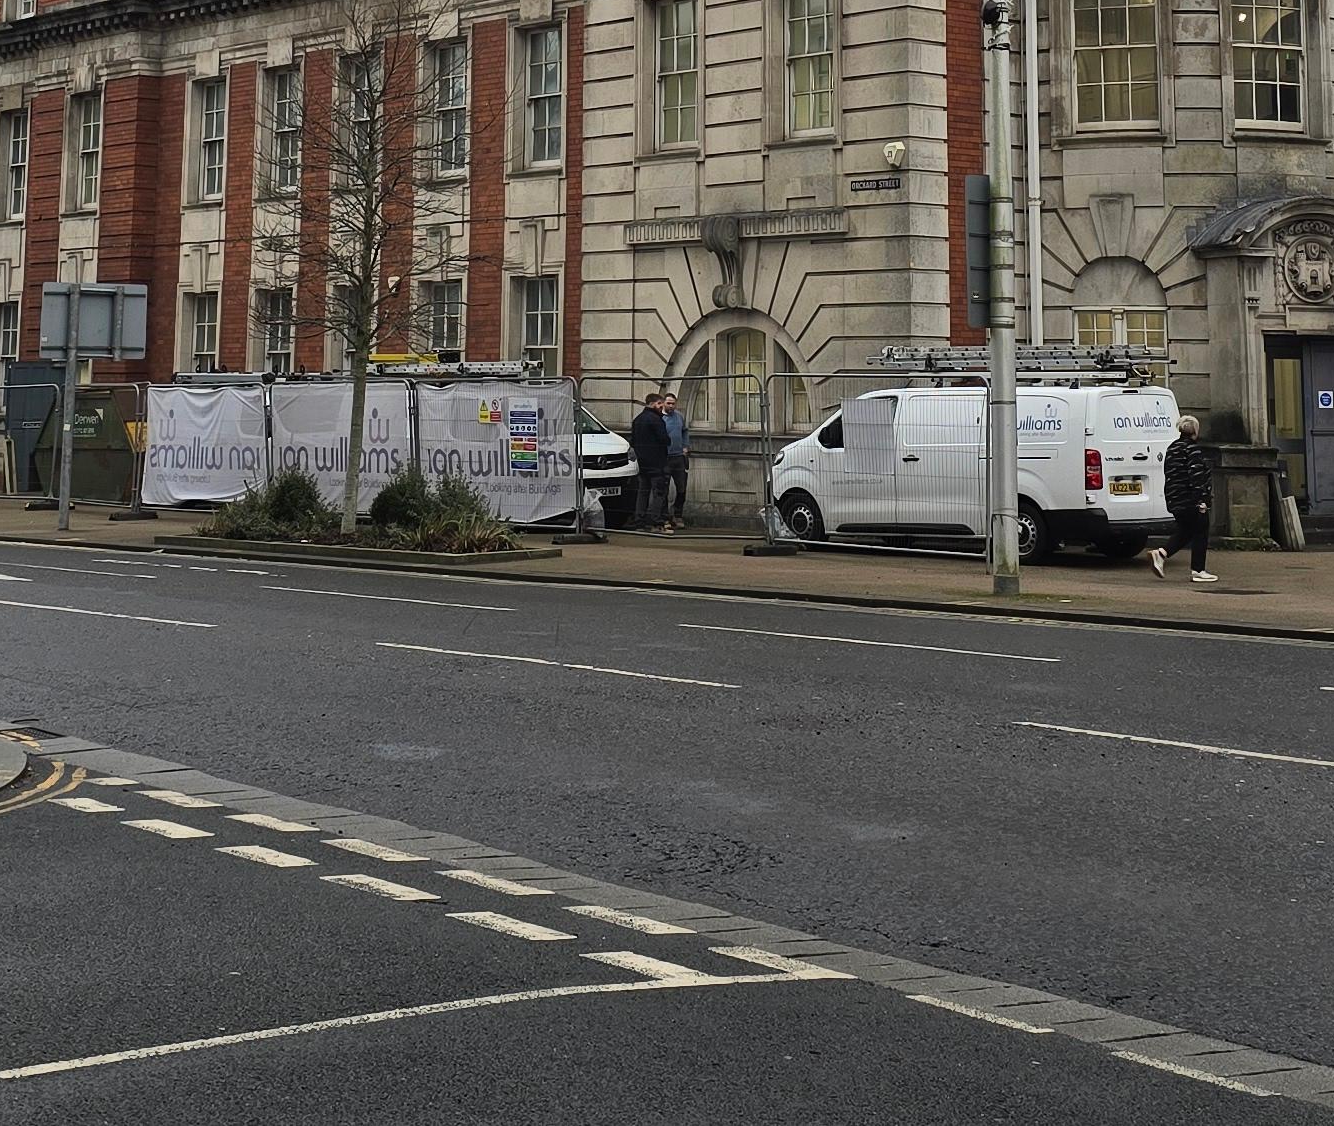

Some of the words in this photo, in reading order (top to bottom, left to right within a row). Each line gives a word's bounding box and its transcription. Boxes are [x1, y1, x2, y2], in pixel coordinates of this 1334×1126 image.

[851, 181, 877, 190] ORCHARD
[878, 179, 899, 188] STREET
[1133, 412, 1172, 428] williams
[314, 436, 400, 475] willams
[468, 438, 573, 478] willms
